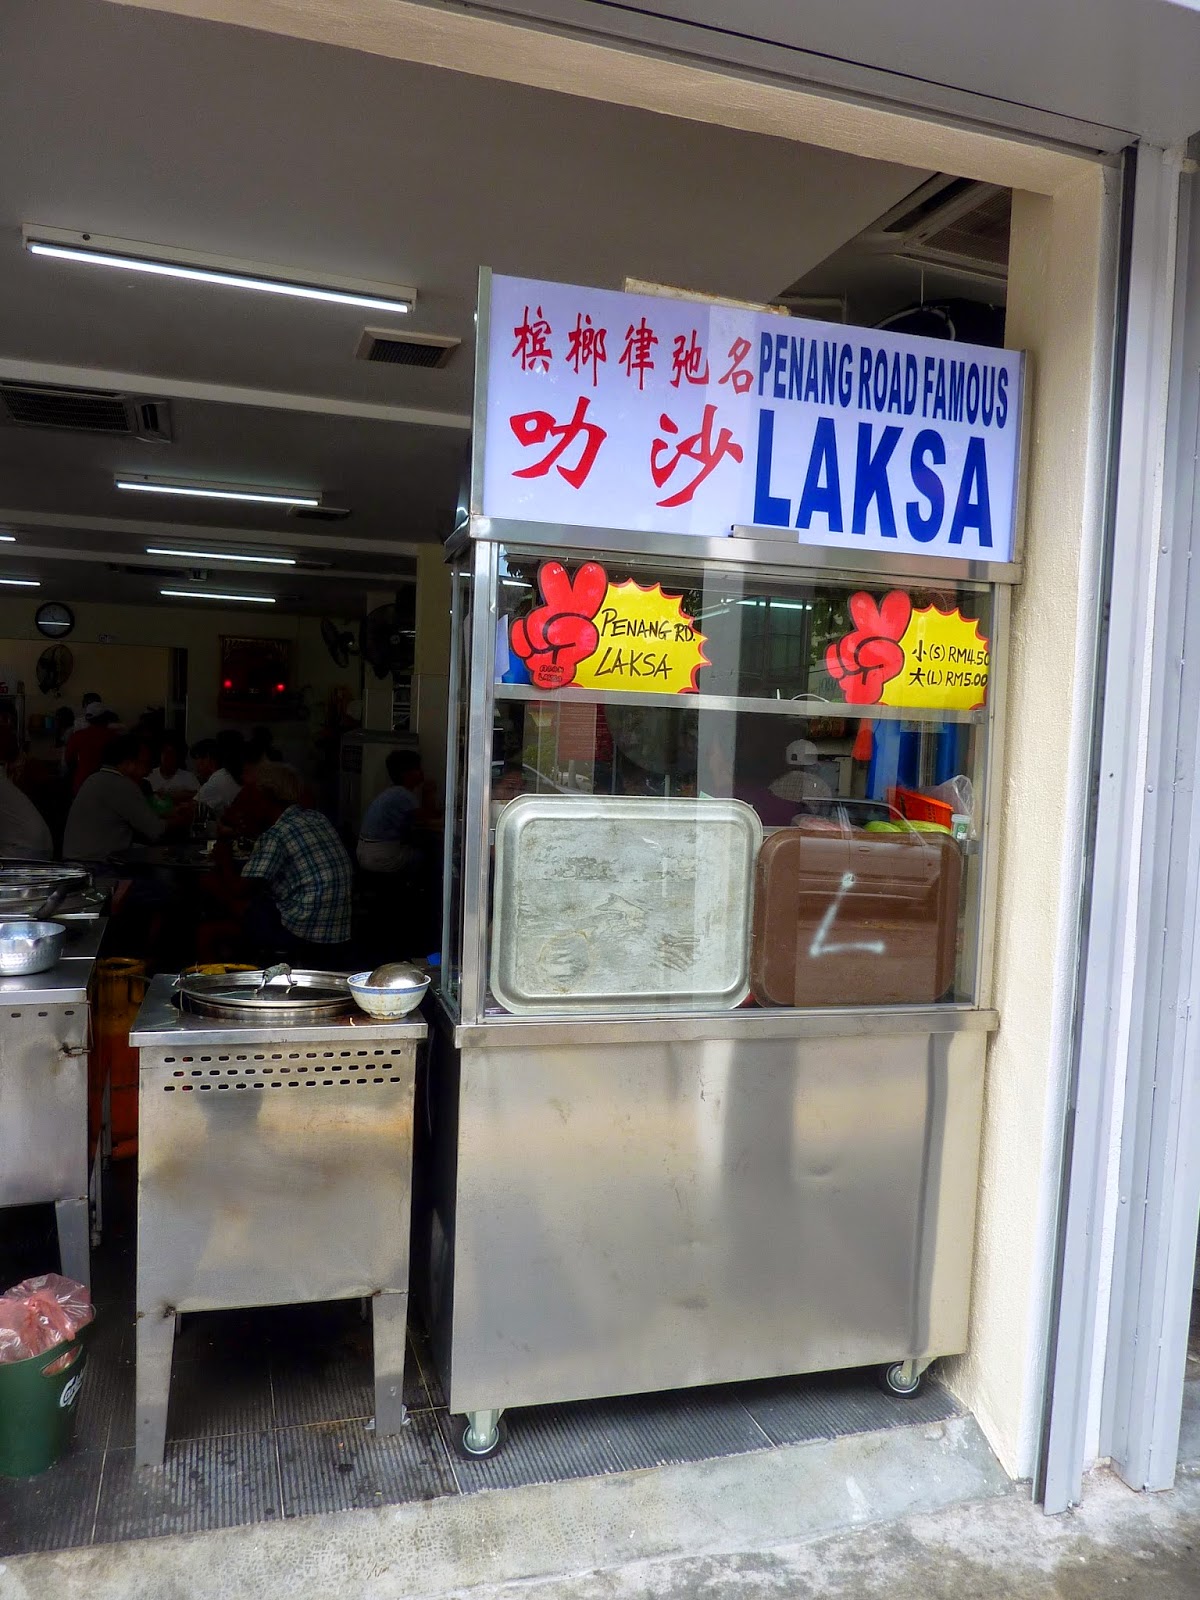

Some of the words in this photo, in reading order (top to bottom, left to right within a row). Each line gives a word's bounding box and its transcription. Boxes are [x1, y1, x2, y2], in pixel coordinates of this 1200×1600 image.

[758, 332, 853, 408] PENANG
[858, 346, 918, 415] ROAD
[922, 356, 1009, 429] FAMOUS
[509, 396, 744, 507] 叻沙
[753, 408, 993, 547] LAKSA
[601, 608, 671, 640] PENANG
[674, 624, 696, 642] RD.
[594, 647, 672, 680] LAKSA
[945, 670, 988, 687] RM5.00
